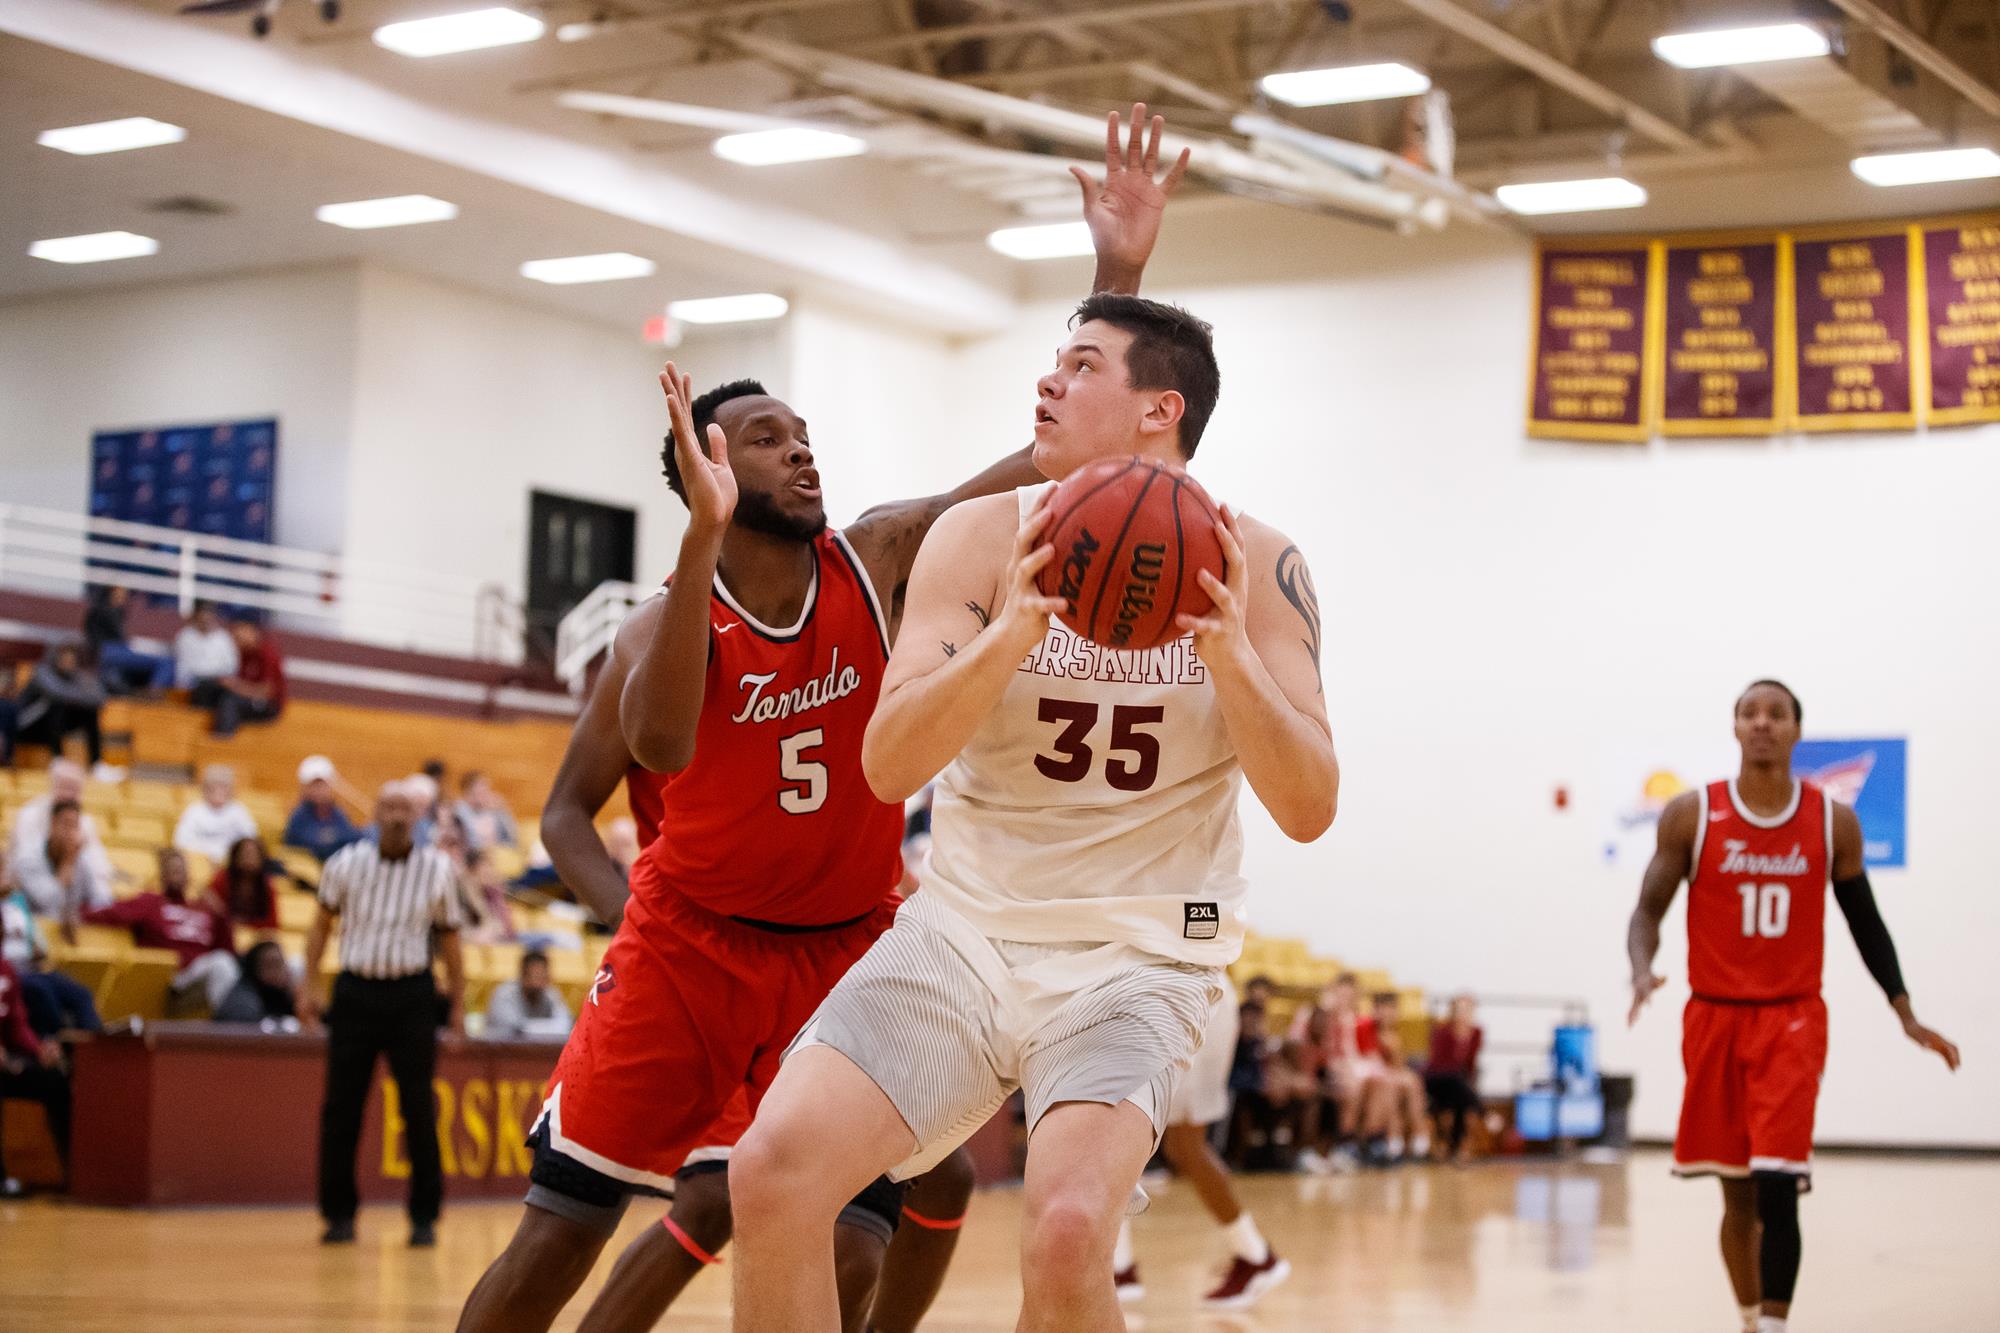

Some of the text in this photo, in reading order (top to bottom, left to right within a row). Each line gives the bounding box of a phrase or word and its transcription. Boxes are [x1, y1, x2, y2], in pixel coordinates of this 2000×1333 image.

[1108, 542, 1167, 645] Wilson
[732, 647, 861, 724] Tornado
[778, 726, 829, 815] 5
[1033, 697, 1165, 792] 35
[1718, 839, 1809, 876] Tornado
[1190, 906, 1216, 918] 2XL
[1737, 883, 1791, 938] 10
[382, 1077, 548, 1178] ERSK
